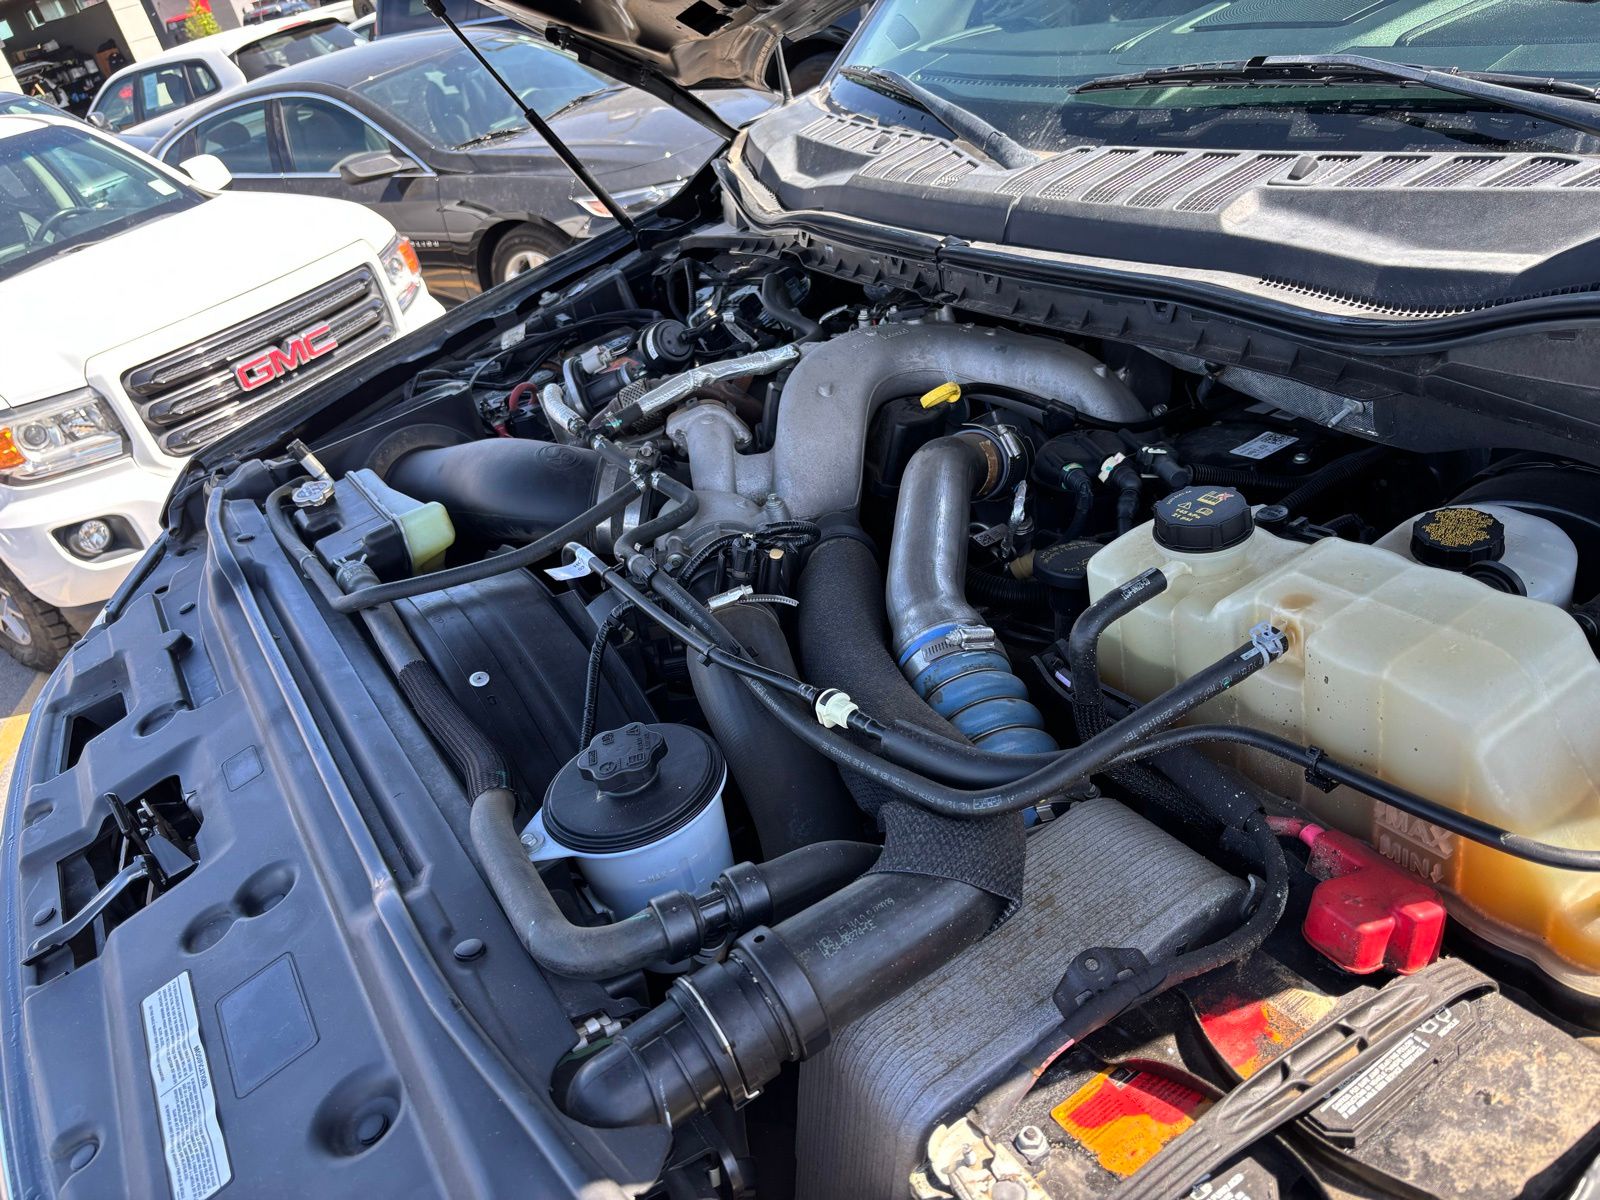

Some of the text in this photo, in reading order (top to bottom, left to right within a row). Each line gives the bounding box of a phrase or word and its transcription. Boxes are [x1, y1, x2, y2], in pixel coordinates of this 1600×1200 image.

[231, 320, 338, 392] GMC
[1385, 802, 1454, 856] MAX
[1379, 833, 1430, 879] MIN
[193, 1044, 208, 1090] MODIFICATIONS
